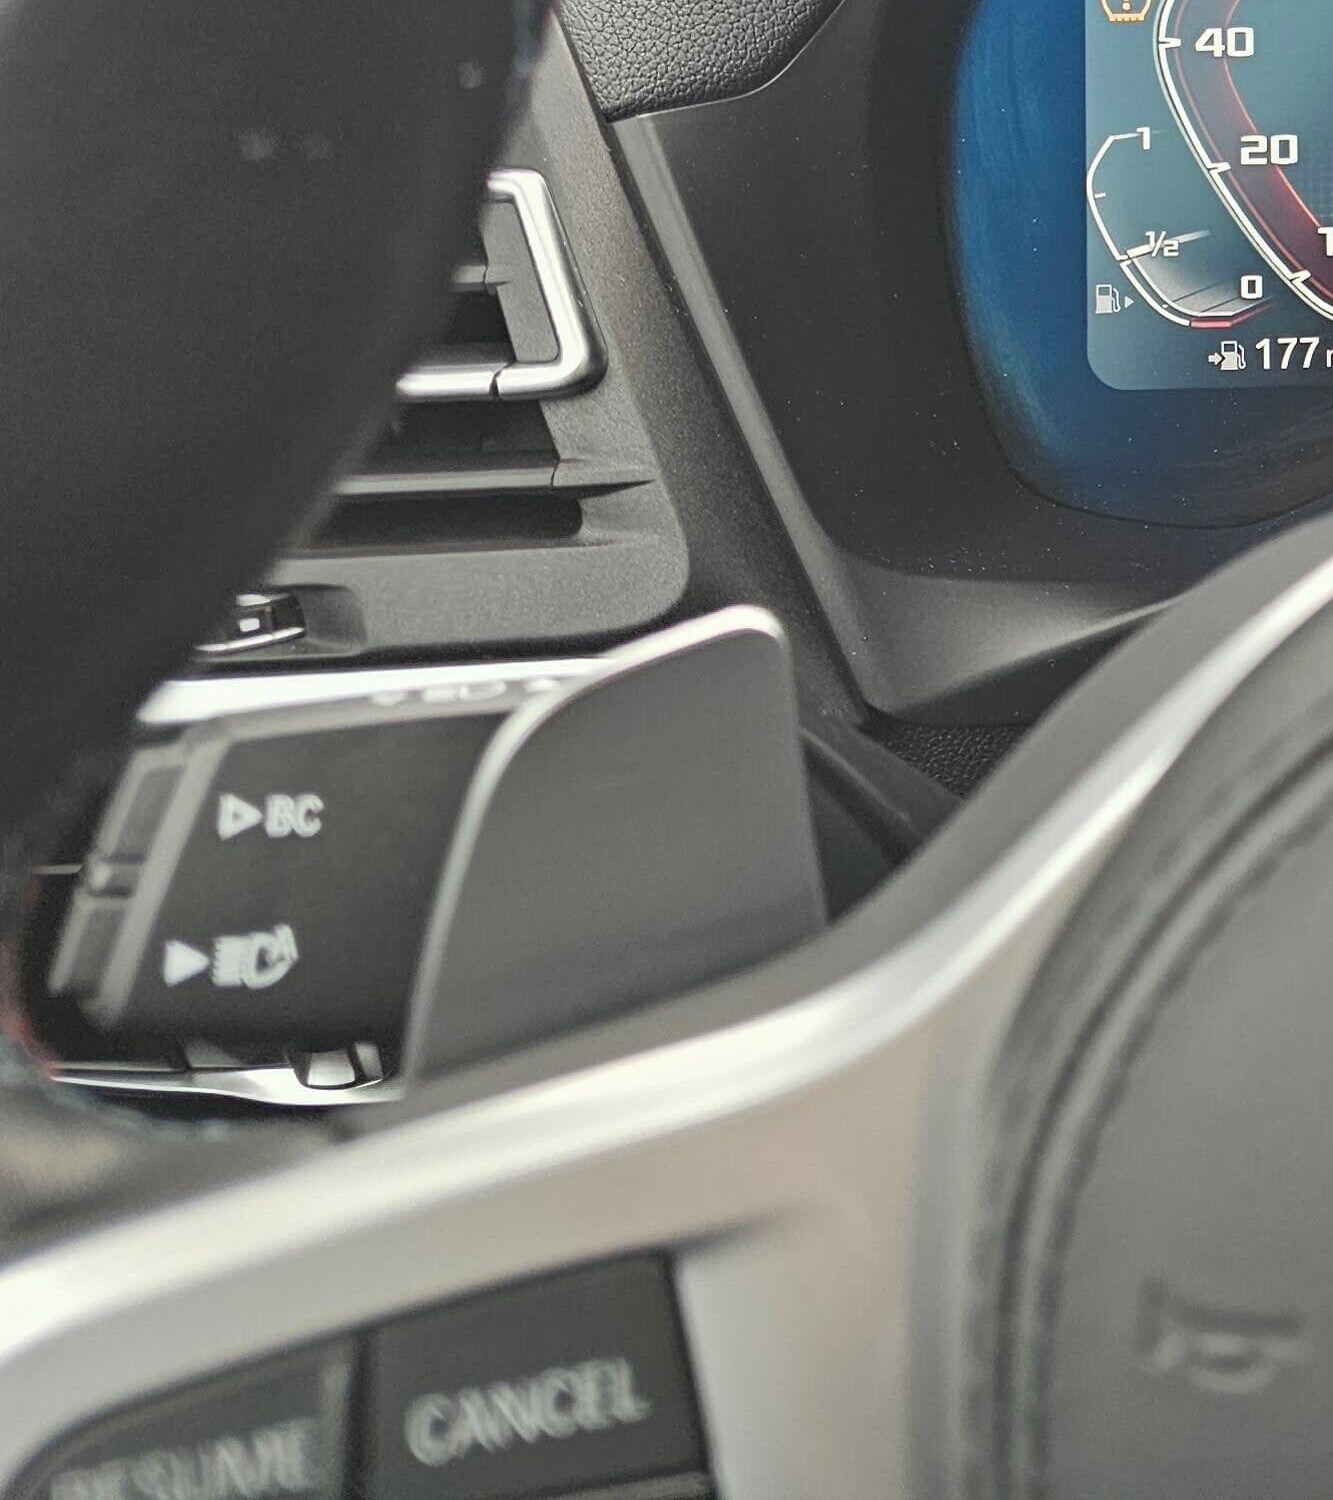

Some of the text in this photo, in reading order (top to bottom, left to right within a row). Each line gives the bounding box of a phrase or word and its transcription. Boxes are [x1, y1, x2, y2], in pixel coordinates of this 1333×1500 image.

[1194, 27, 1255, 58] 40
[1239, 134, 1299, 166] 20
[1239, 275, 1264, 300] 0
[1254, 336, 1320, 370] 177
[265, 792, 325, 838] BC
[403, 1356, 653, 1468] CANCEL
